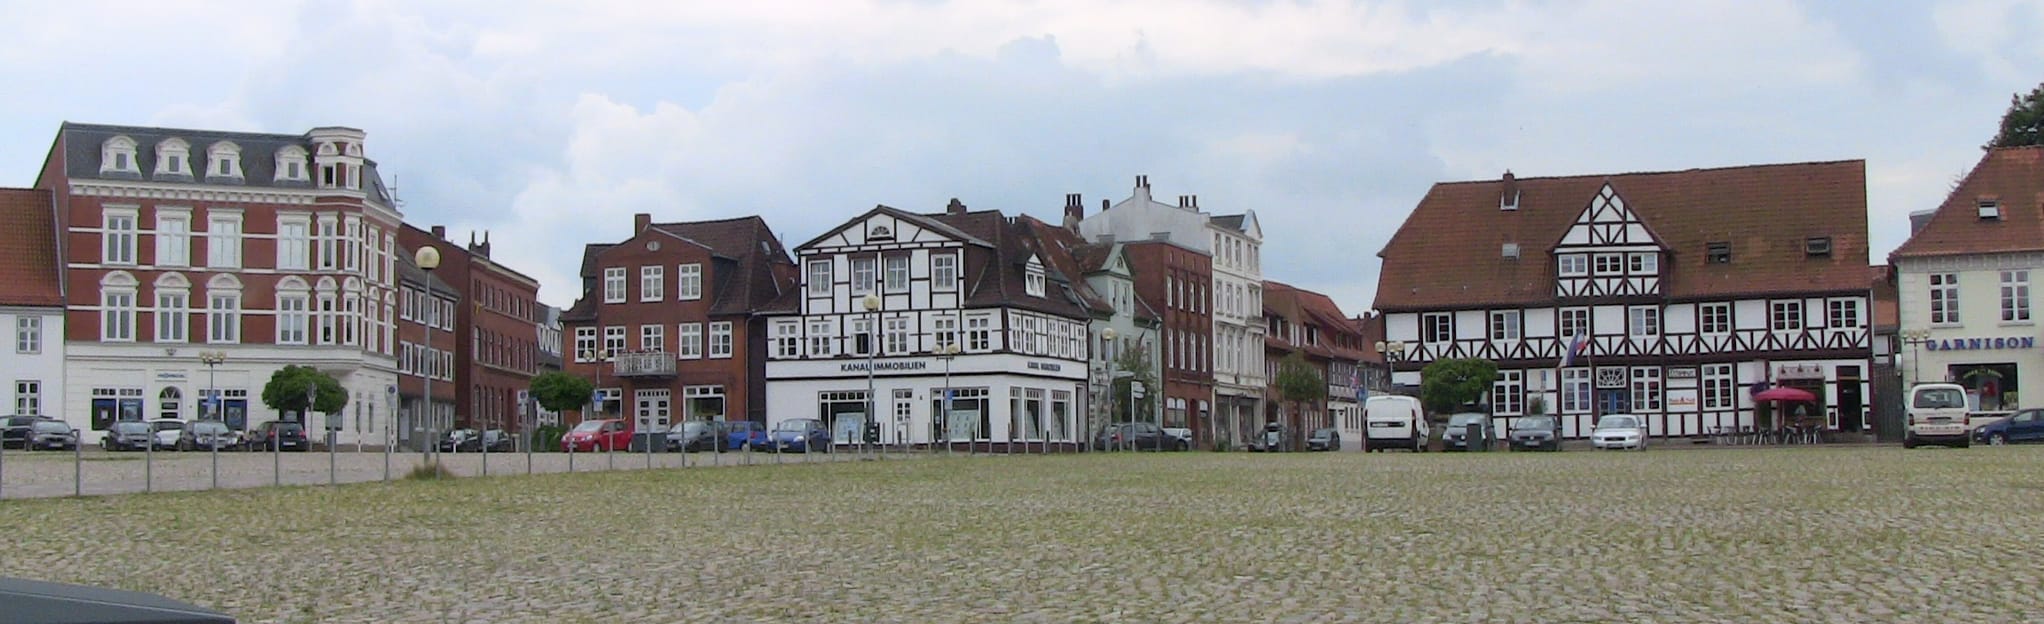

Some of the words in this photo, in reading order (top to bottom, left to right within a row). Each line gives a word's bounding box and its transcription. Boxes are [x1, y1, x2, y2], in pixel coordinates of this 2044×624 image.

[1925, 336, 2034, 351] GARNISON
[840, 363, 871, 372] KANAL
[873, 361, 926, 371] IMMOBILIEN
